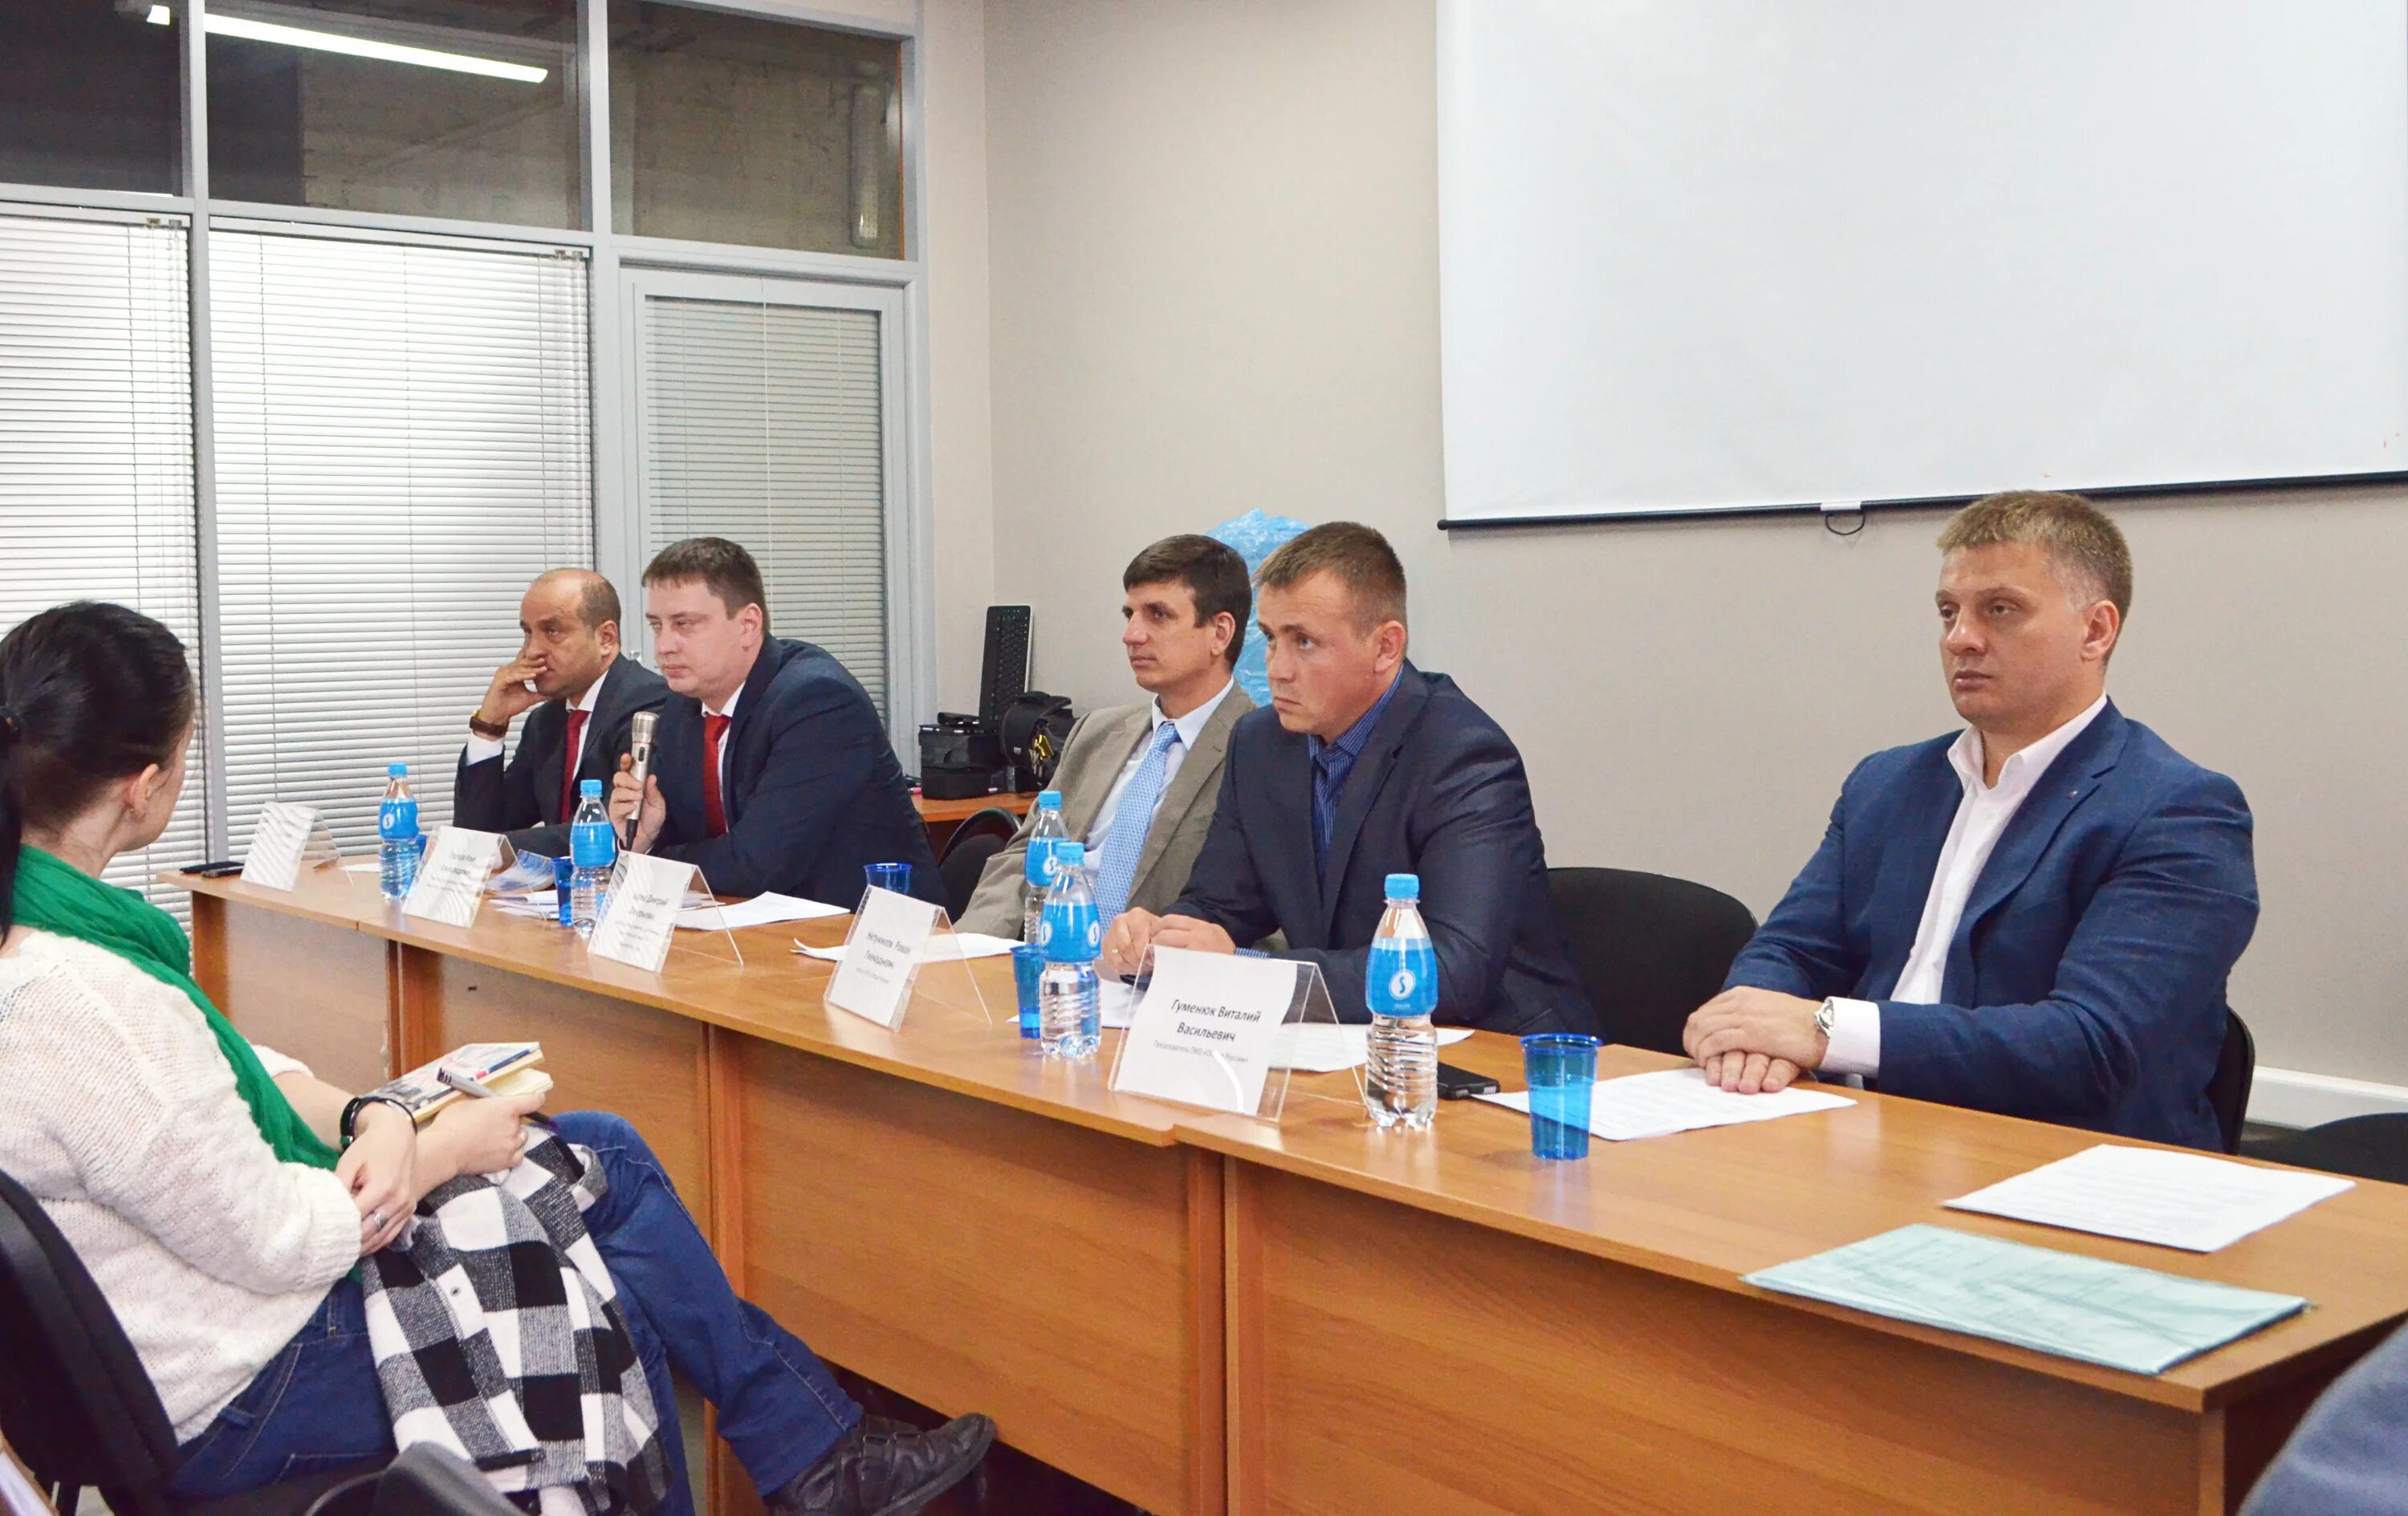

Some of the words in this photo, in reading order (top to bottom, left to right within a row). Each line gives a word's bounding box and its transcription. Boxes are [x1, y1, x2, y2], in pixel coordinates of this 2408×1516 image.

[1171, 998, 1217, 1016] Гуменюк
[1218, 1006, 1263, 1023] Виталий
[1177, 1022, 1236, 1043] Васильевич
